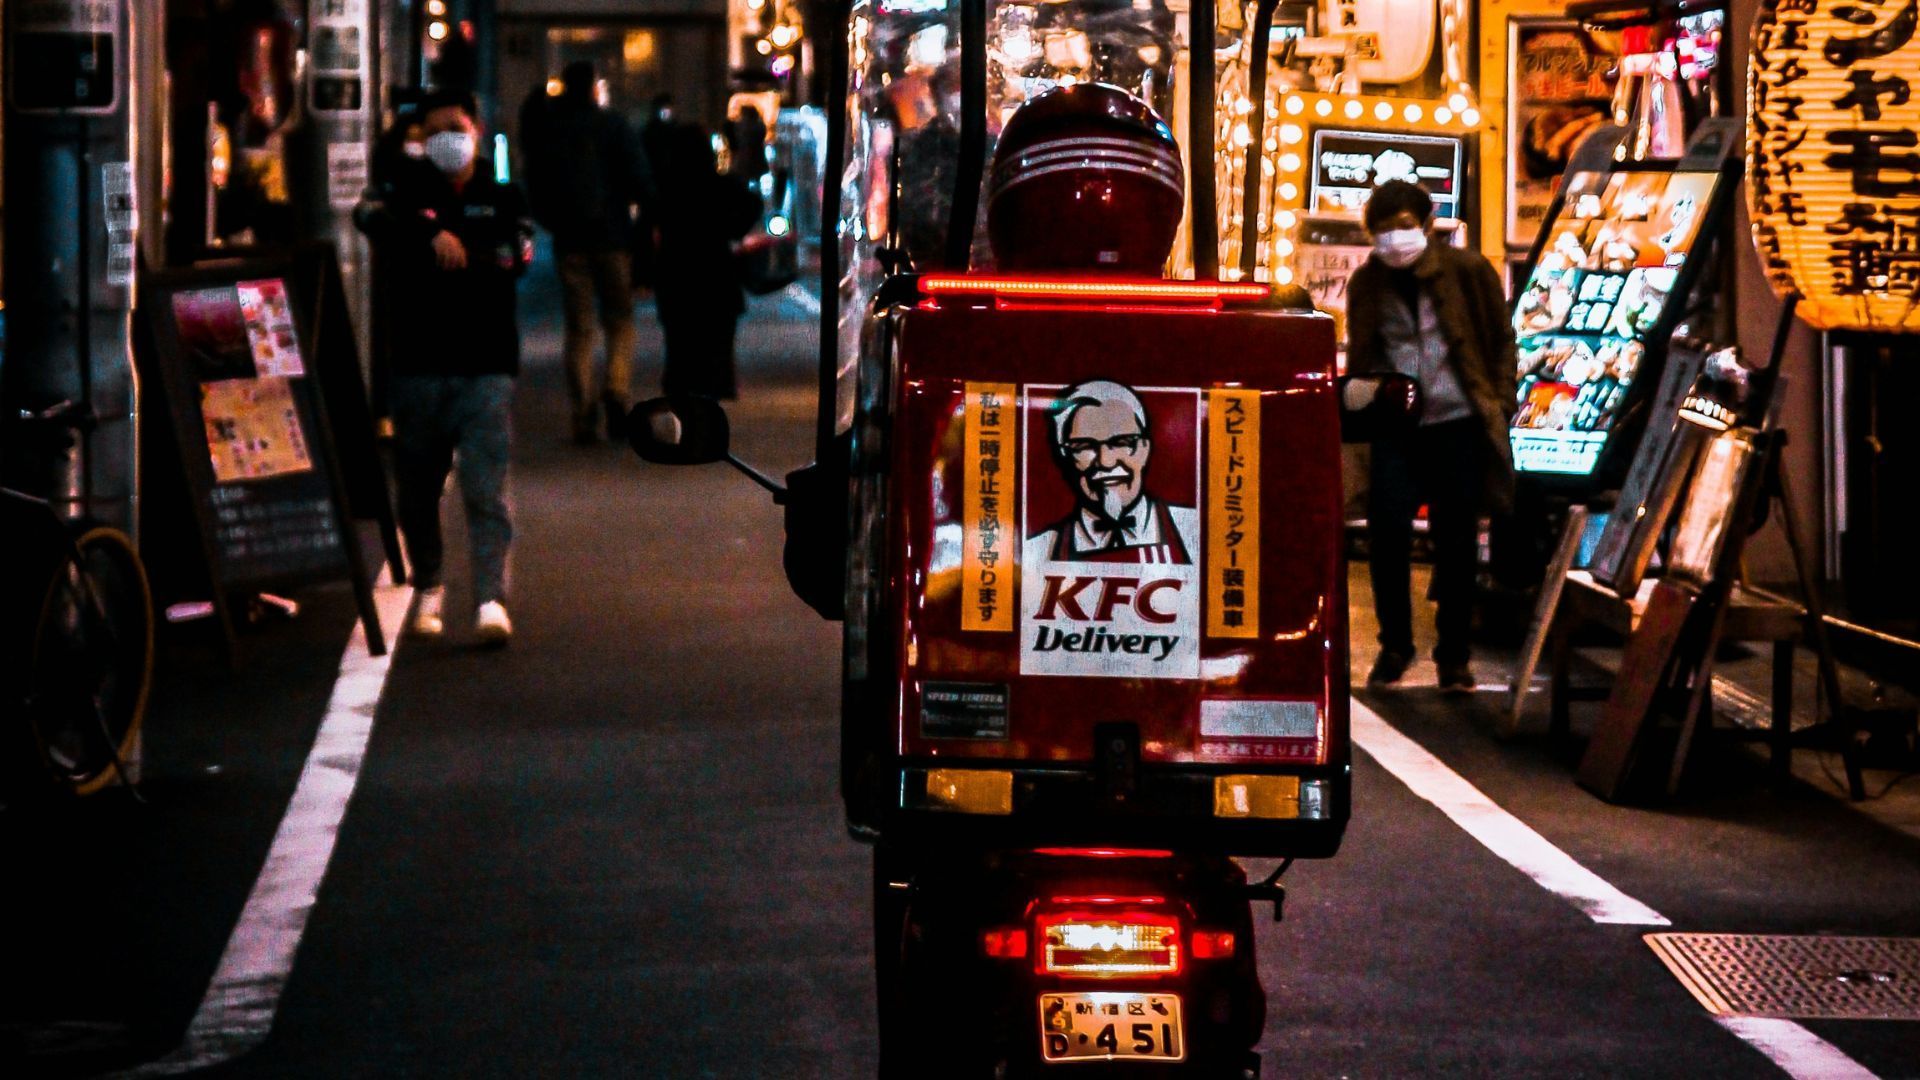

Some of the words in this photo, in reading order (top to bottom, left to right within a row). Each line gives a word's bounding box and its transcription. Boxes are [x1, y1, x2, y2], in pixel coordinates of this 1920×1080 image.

[978, 391, 1001, 622] 私は一時停止を必ず守ります
[1222, 397, 1245, 628] スピードリミッター装備車
[1033, 575, 1183, 624] KFC
[1033, 625, 1180, 662] Delivery
[1075, 1002, 1146, 1016] 新宿区
